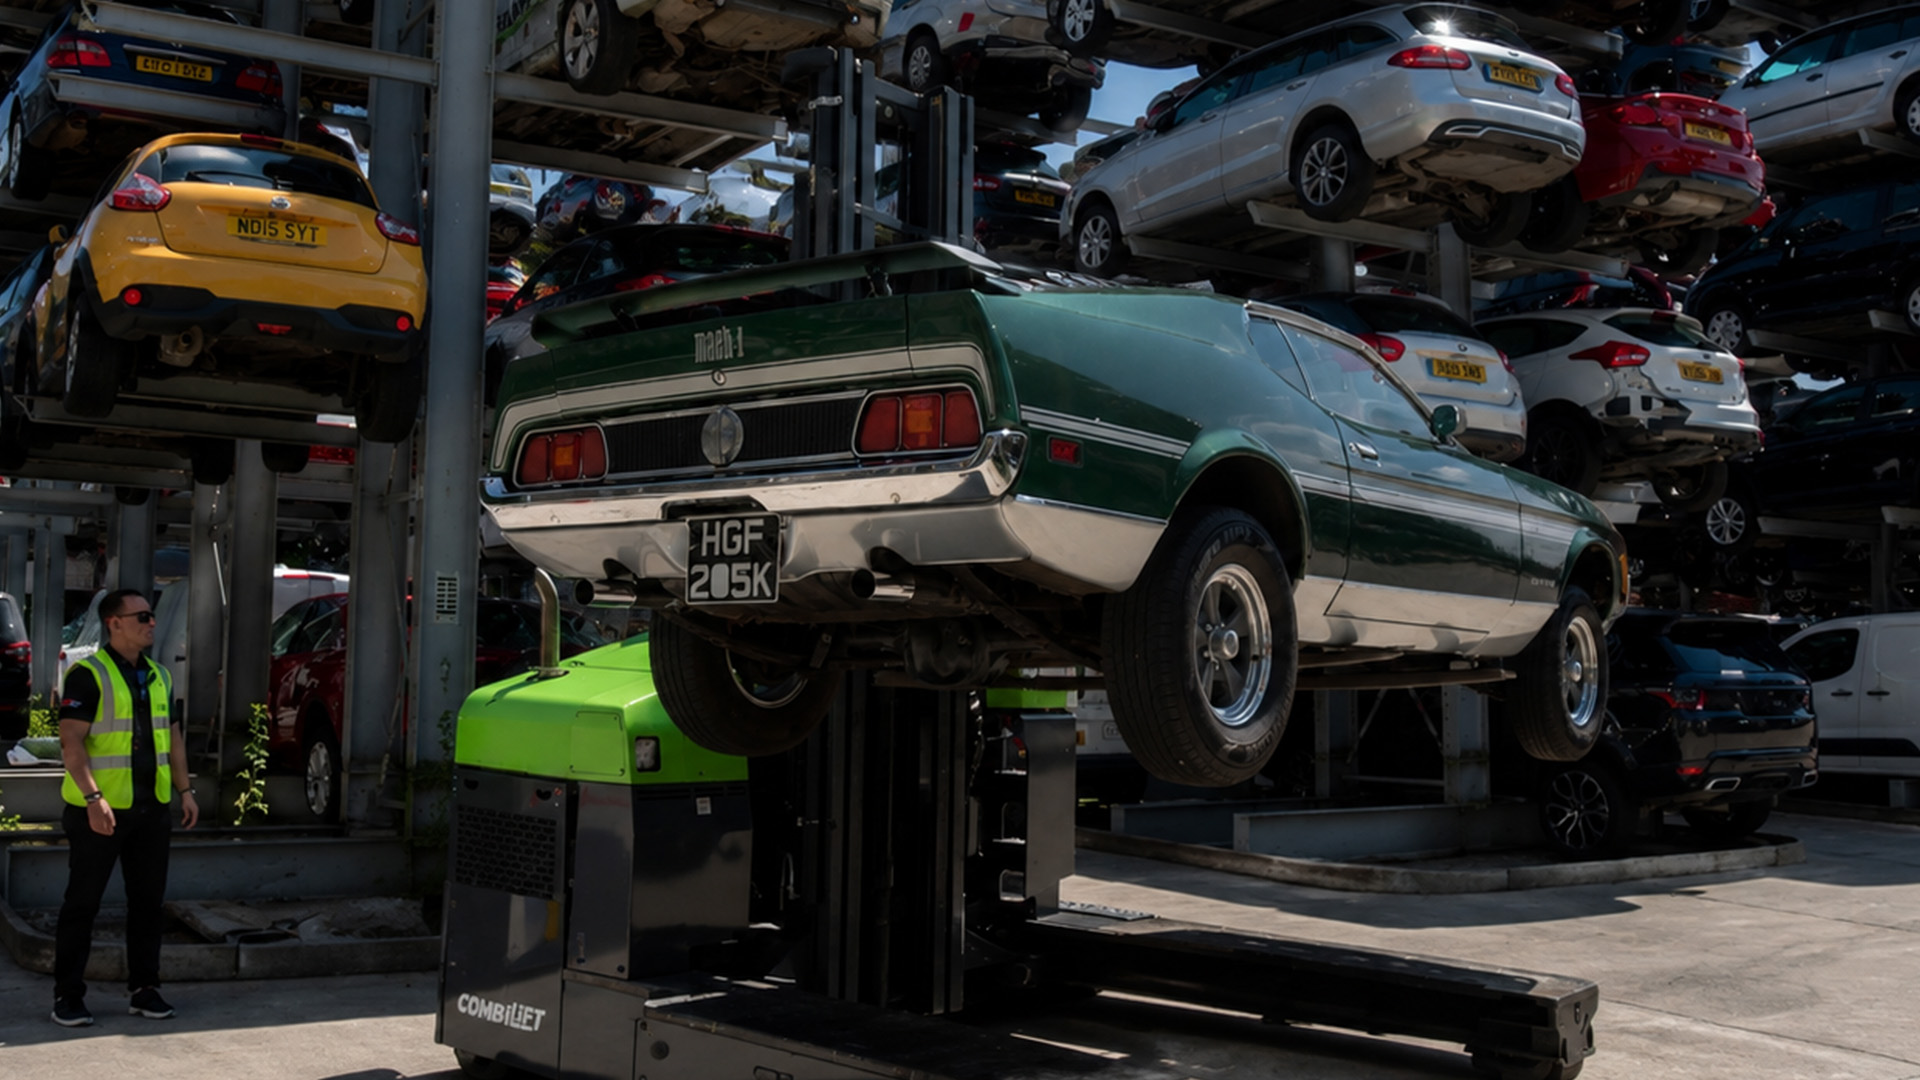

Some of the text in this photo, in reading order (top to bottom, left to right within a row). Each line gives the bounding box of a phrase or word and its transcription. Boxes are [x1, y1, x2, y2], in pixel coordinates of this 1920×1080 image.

[237, 218, 319, 242] ND15 SYT
[701, 519, 764, 556] HGF
